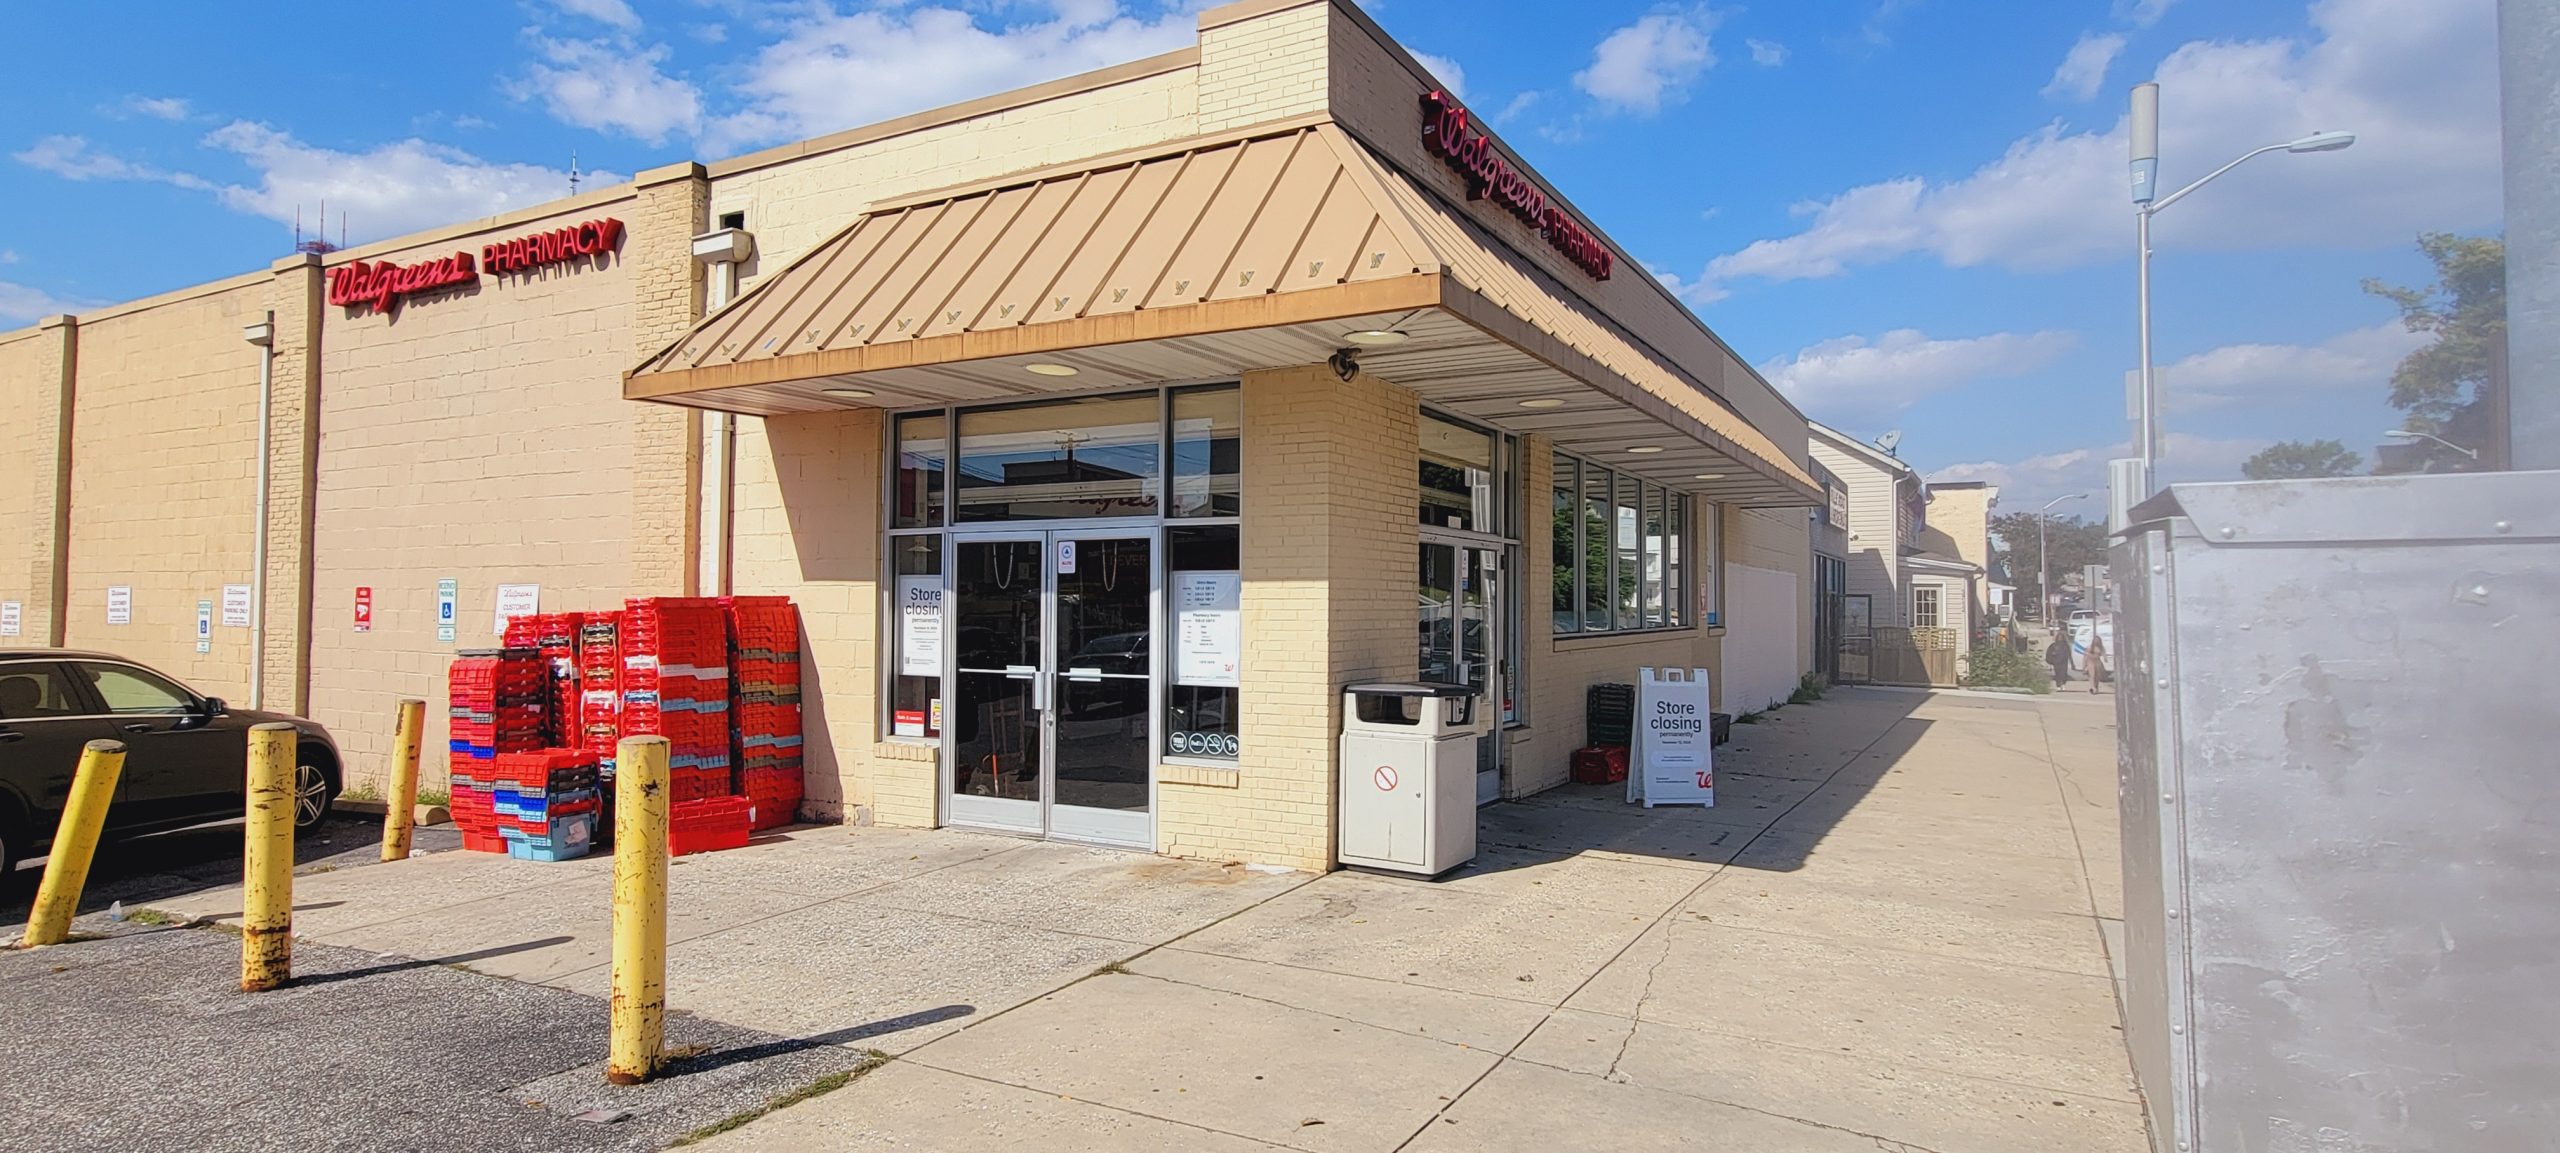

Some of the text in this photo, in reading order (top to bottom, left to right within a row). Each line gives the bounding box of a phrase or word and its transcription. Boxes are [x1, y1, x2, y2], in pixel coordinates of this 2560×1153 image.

[1420, 90, 1614, 281] Walgreens PHARMACY
[326, 217, 623, 314] Walgreens PHARMACY
[910, 587, 942, 601] Store
[1656, 700, 1695, 715] Store
[1651, 716, 1702, 732] closing
[1659, 731, 1694, 739] permanently
